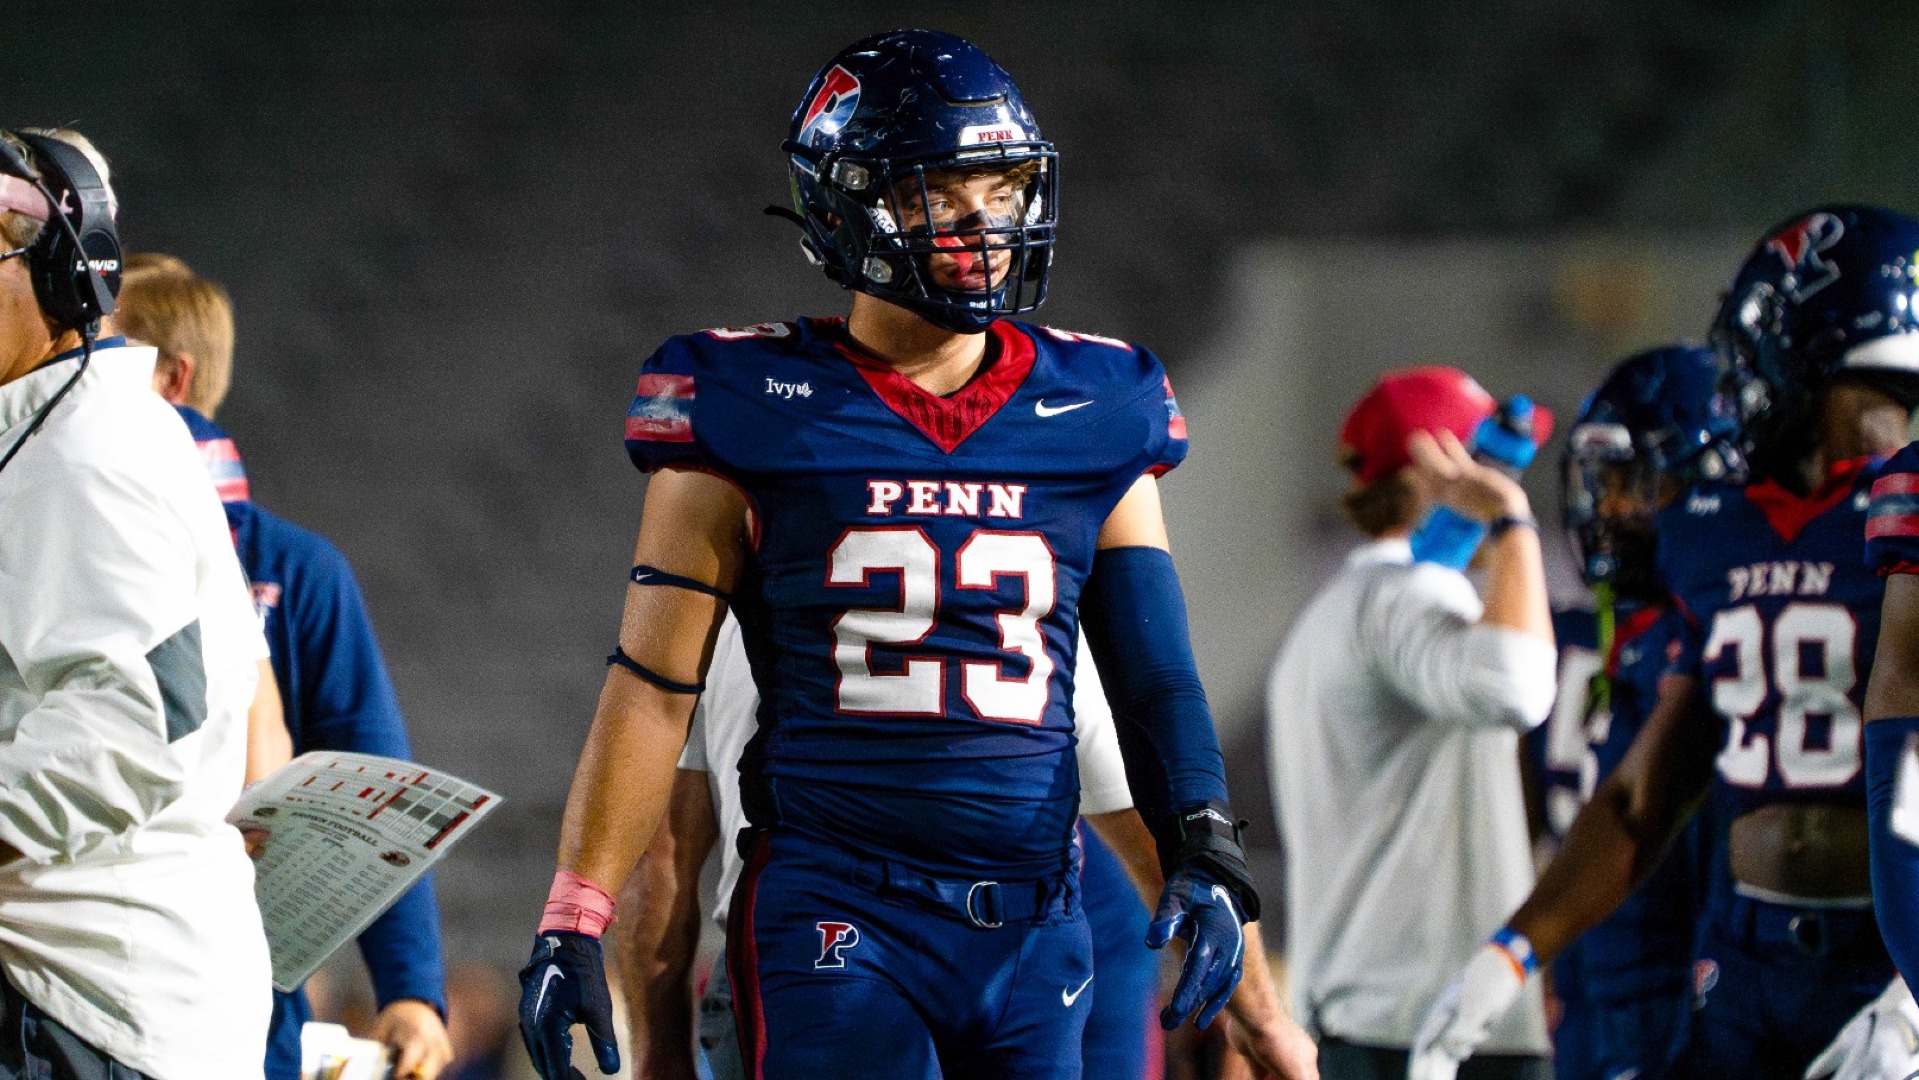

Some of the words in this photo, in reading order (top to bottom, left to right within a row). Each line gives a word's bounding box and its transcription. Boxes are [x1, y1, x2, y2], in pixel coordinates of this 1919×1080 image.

[977, 130, 1014, 142] PENN
[765, 378, 796, 399] Ivy
[867, 479, 1027, 519] PENN
[1727, 561, 1835, 601] PENN
[824, 525, 1057, 725] 23
[1703, 602, 1863, 789] 28
[815, 921, 859, 969] P
